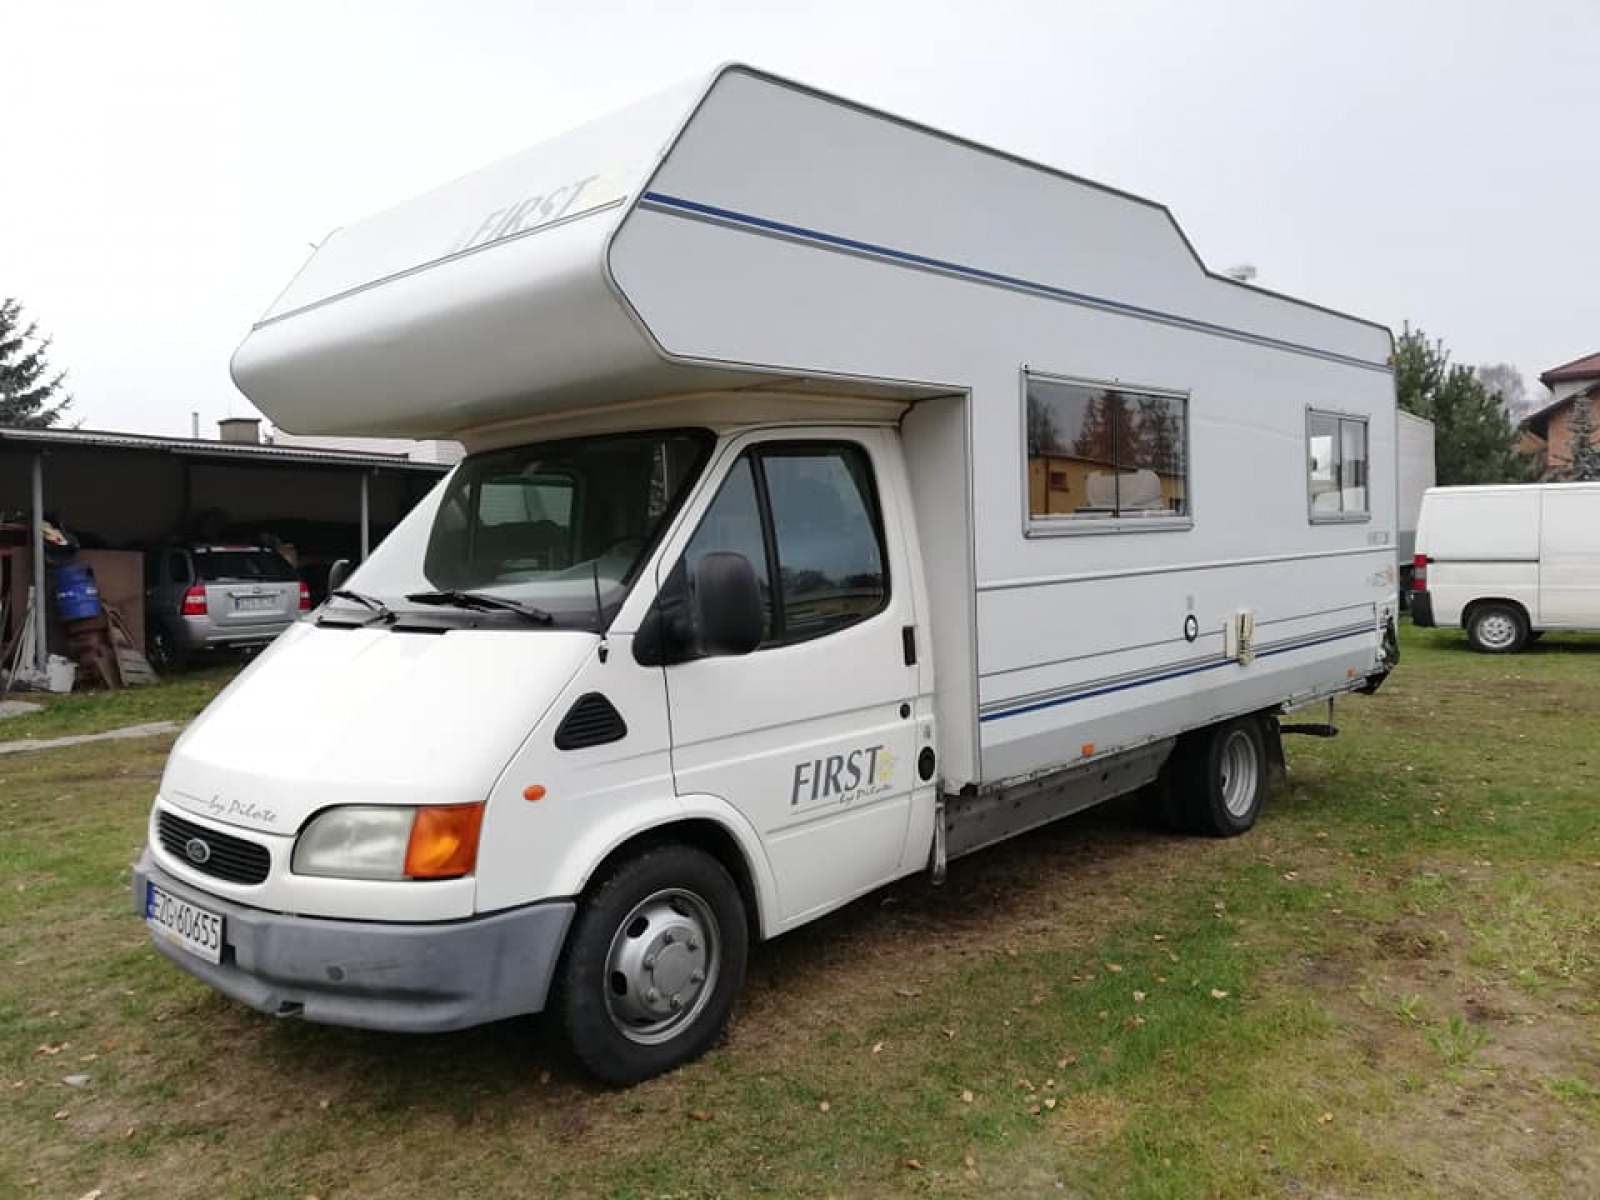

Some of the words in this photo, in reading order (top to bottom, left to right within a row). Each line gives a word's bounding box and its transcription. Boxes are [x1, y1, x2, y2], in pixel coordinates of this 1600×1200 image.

[464, 173, 601, 248] FIRST
[790, 744, 884, 806] FIRST
[209, 794, 226, 815] by
[227, 799, 278, 822] Pilote
[177, 904, 219, 951] 60655
